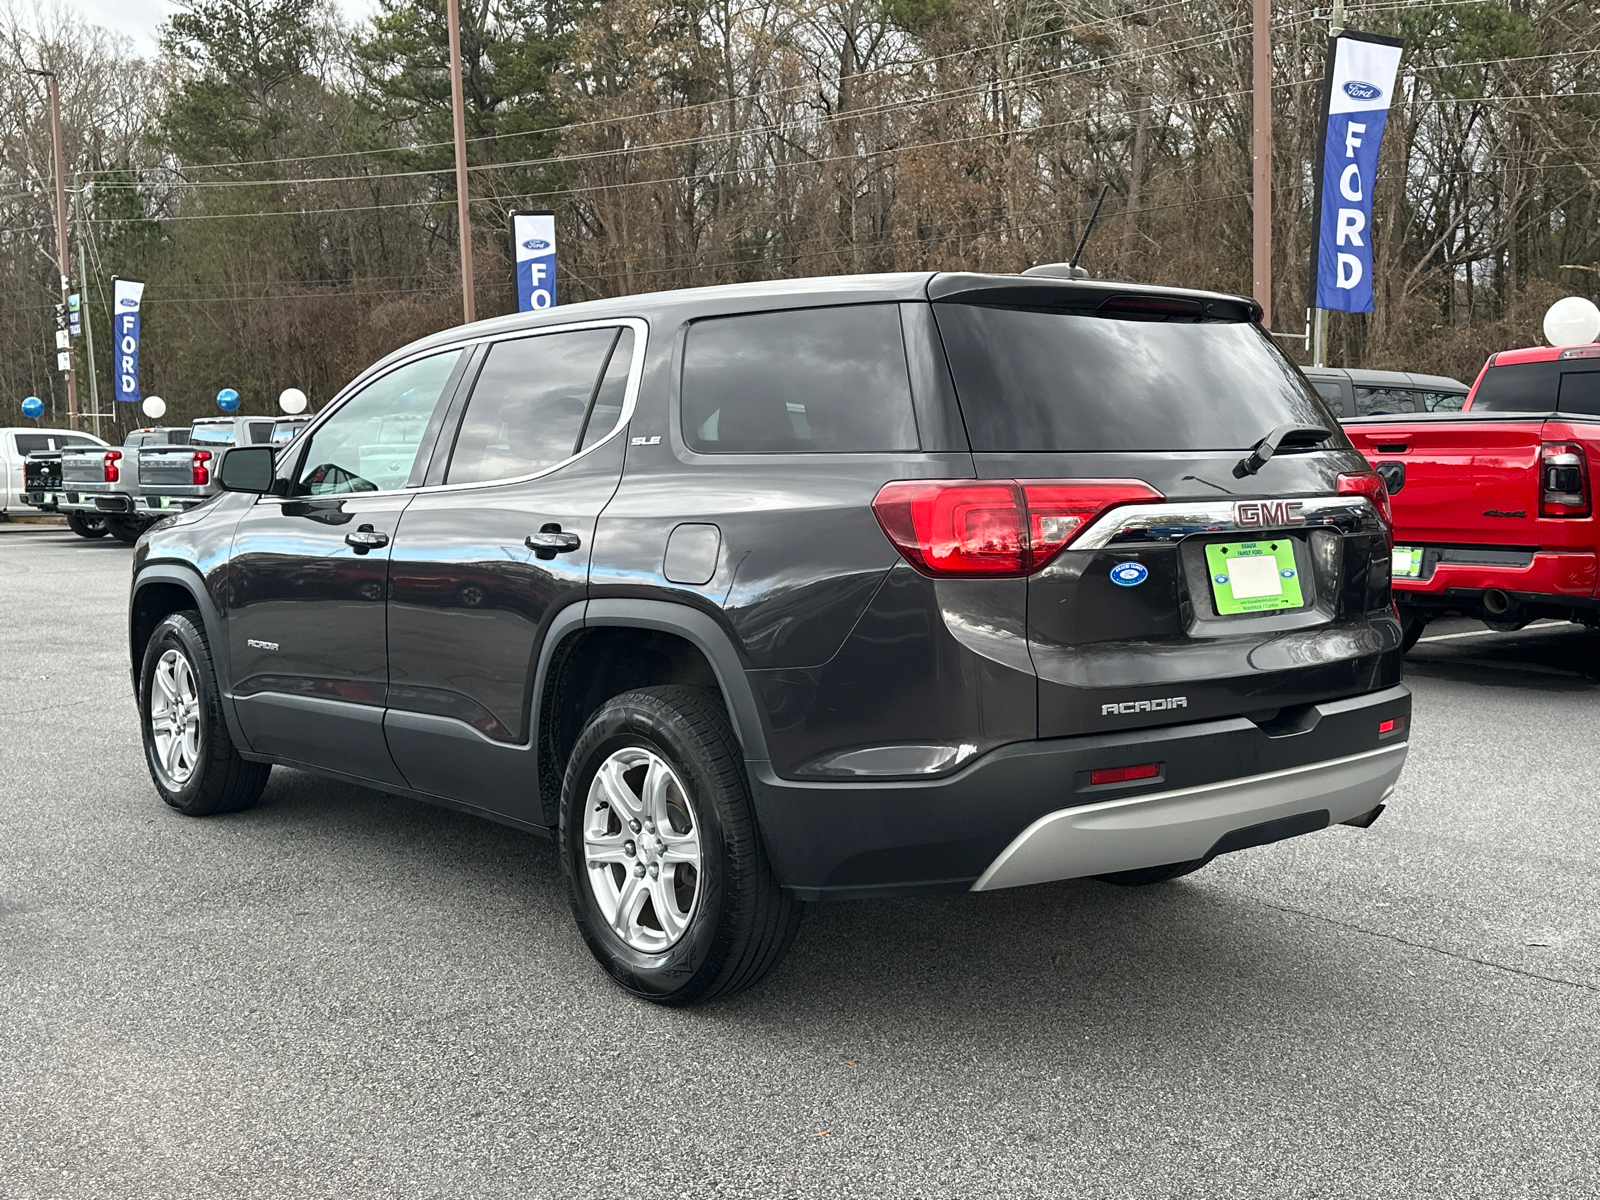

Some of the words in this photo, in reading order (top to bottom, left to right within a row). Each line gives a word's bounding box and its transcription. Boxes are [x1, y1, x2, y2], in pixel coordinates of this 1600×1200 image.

[1336, 120, 1367, 290] FORD
[121, 315, 136, 393] FORD
[630, 435, 662, 446] SLE
[1237, 501, 1306, 526] GMC
[247, 639, 279, 651] ACADIA
[1101, 696, 1188, 716] ACADIA
